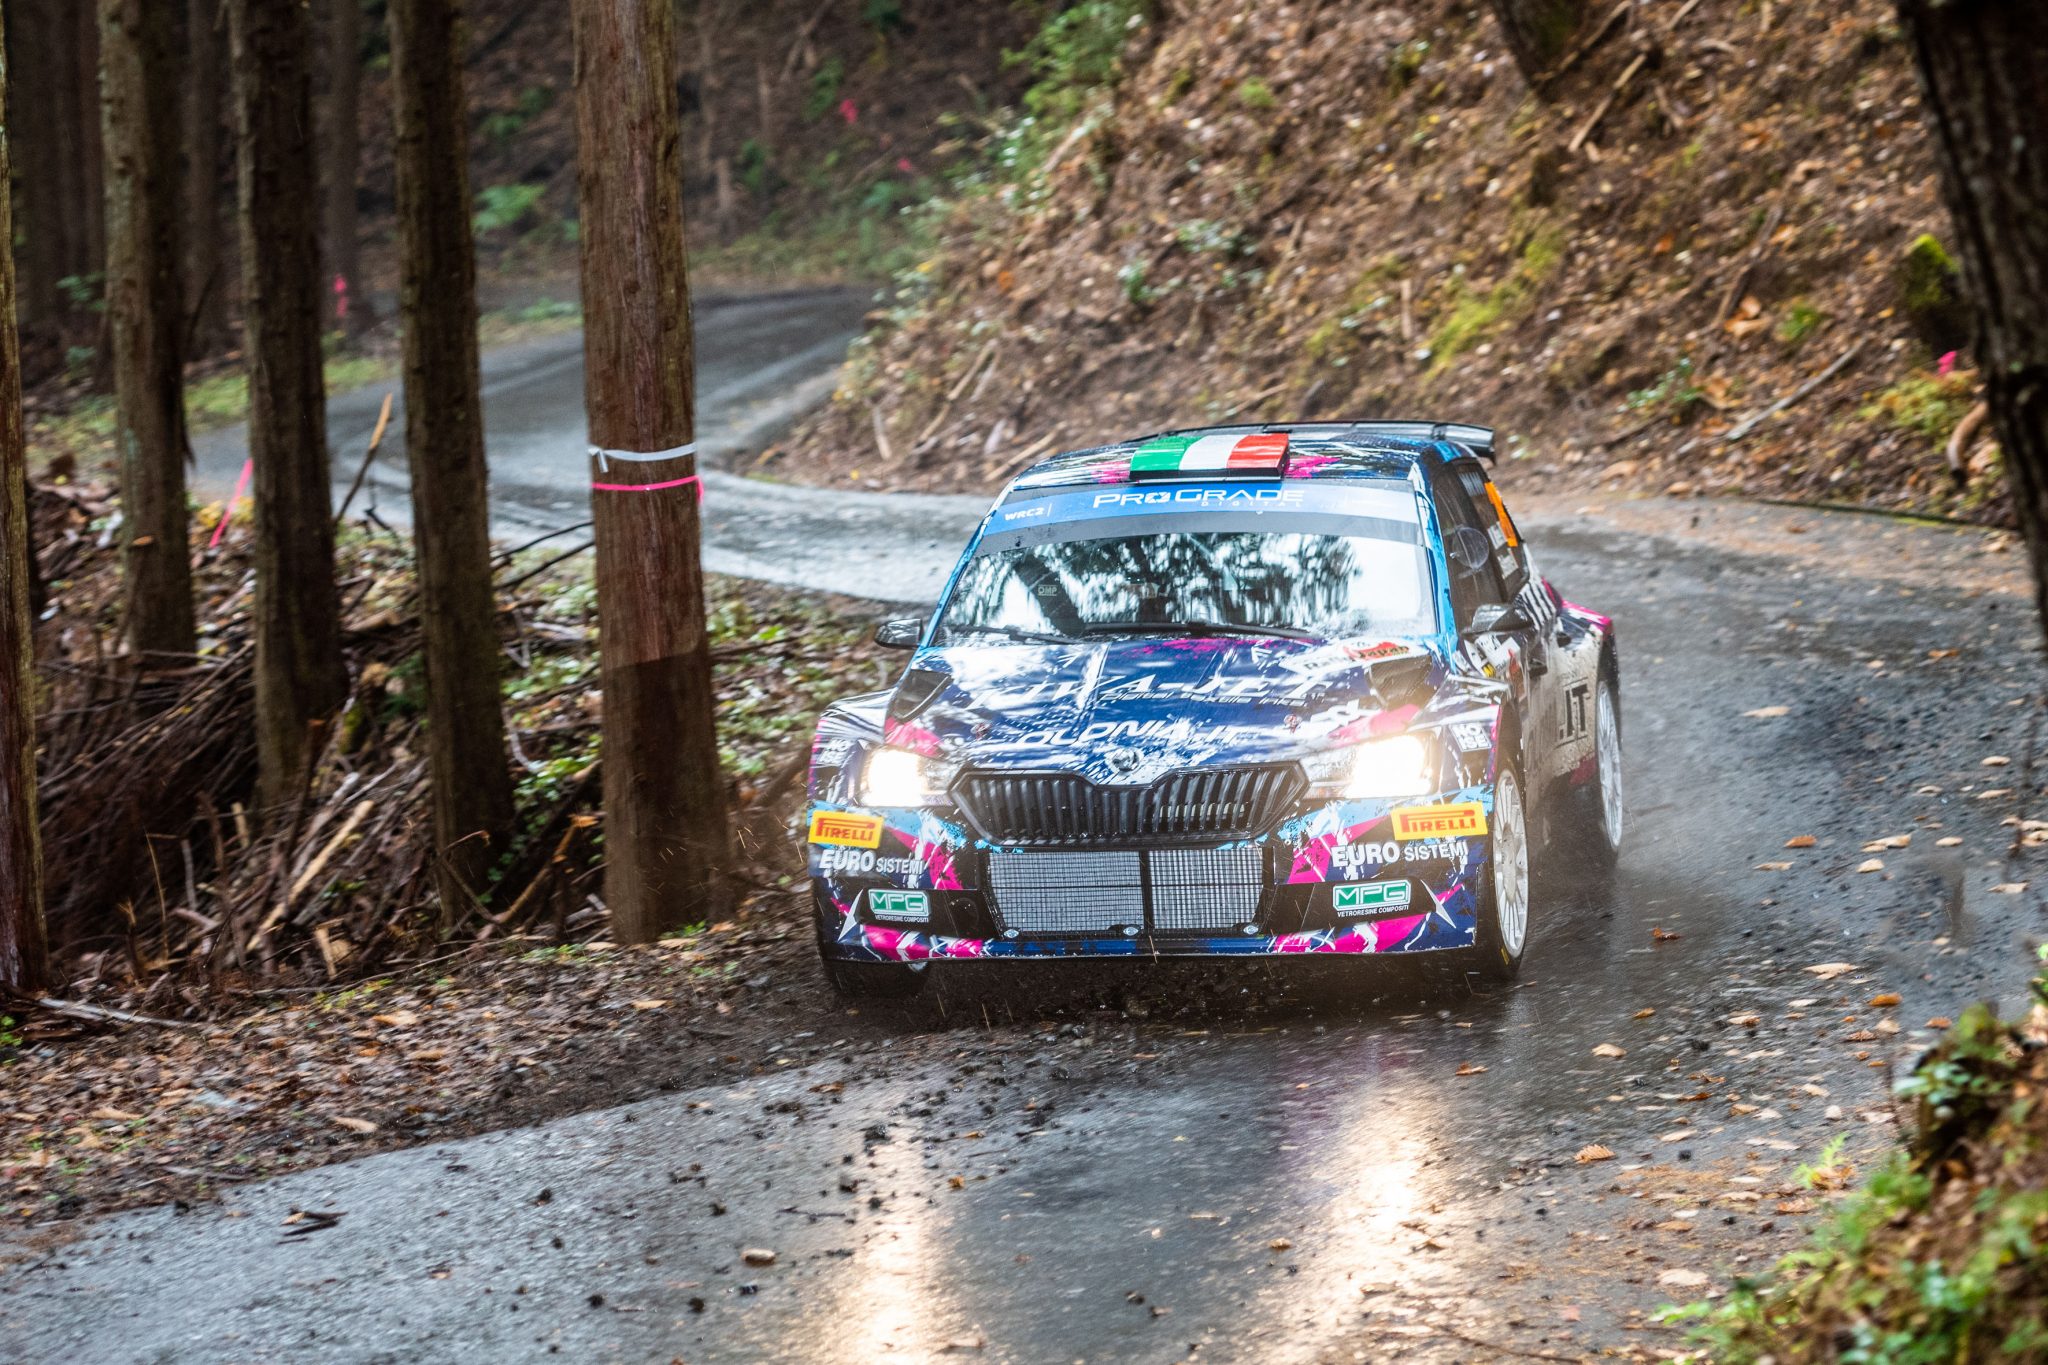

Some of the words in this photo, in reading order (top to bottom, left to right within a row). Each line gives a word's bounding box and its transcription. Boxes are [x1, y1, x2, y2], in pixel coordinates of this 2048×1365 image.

[1004, 506, 1045, 521] WRC2
[816, 817, 876, 841] PIRELLI
[1400, 809, 1476, 833] PIRELLI
[819, 849, 876, 872] EURO
[876, 856, 925, 875] SISTEMI
[1331, 842, 1401, 867] EURO
[1404, 840, 1469, 862] SISTEMI
[870, 892, 924, 912] MPG
[1335, 882, 1408, 908] MPG
[1337, 908, 1378, 918] VETRORESINE
[1378, 904, 1410, 914] COMPOSITI
